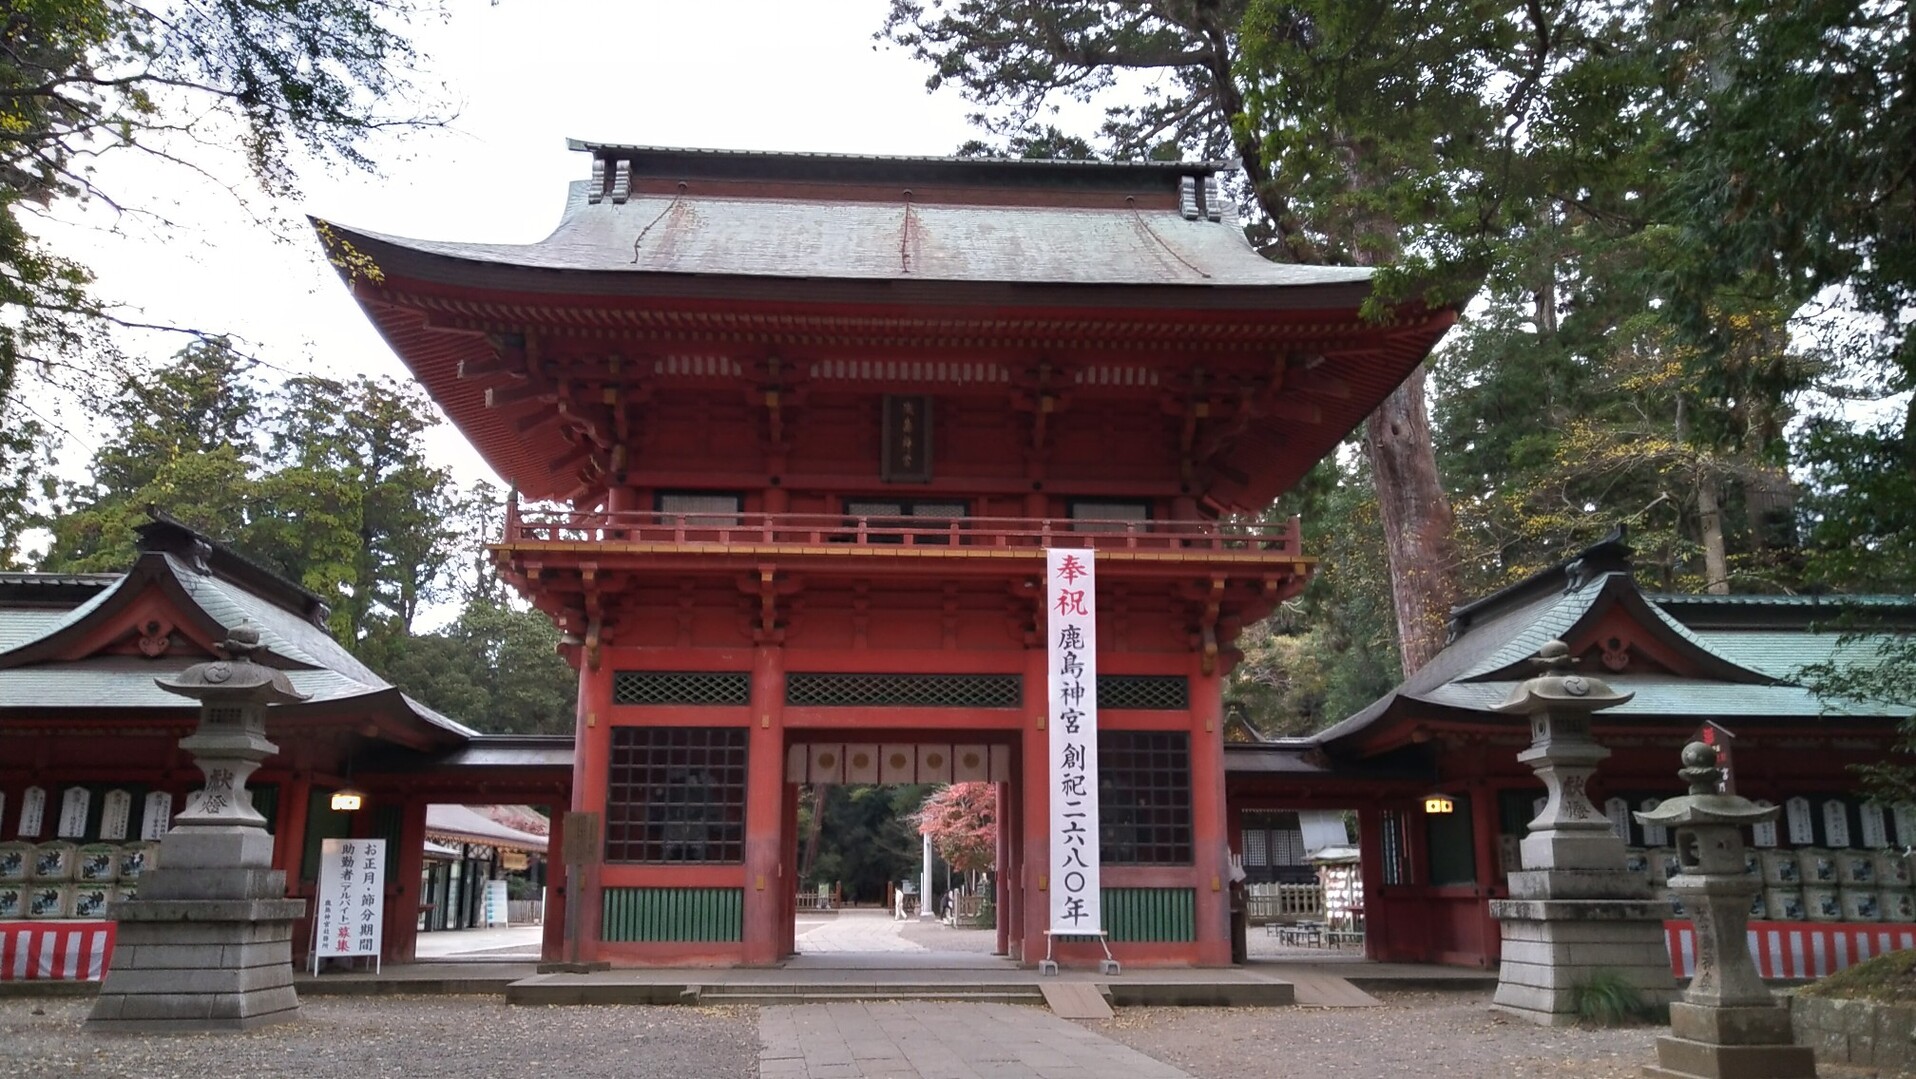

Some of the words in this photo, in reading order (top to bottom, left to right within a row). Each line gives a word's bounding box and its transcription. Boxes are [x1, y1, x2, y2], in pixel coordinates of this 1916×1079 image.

[1053, 554, 1089, 618] 奉祝
[1057, 623, 1086, 736] 鹿島神宮
[358, 842, 378, 952] お正月・節分期間
